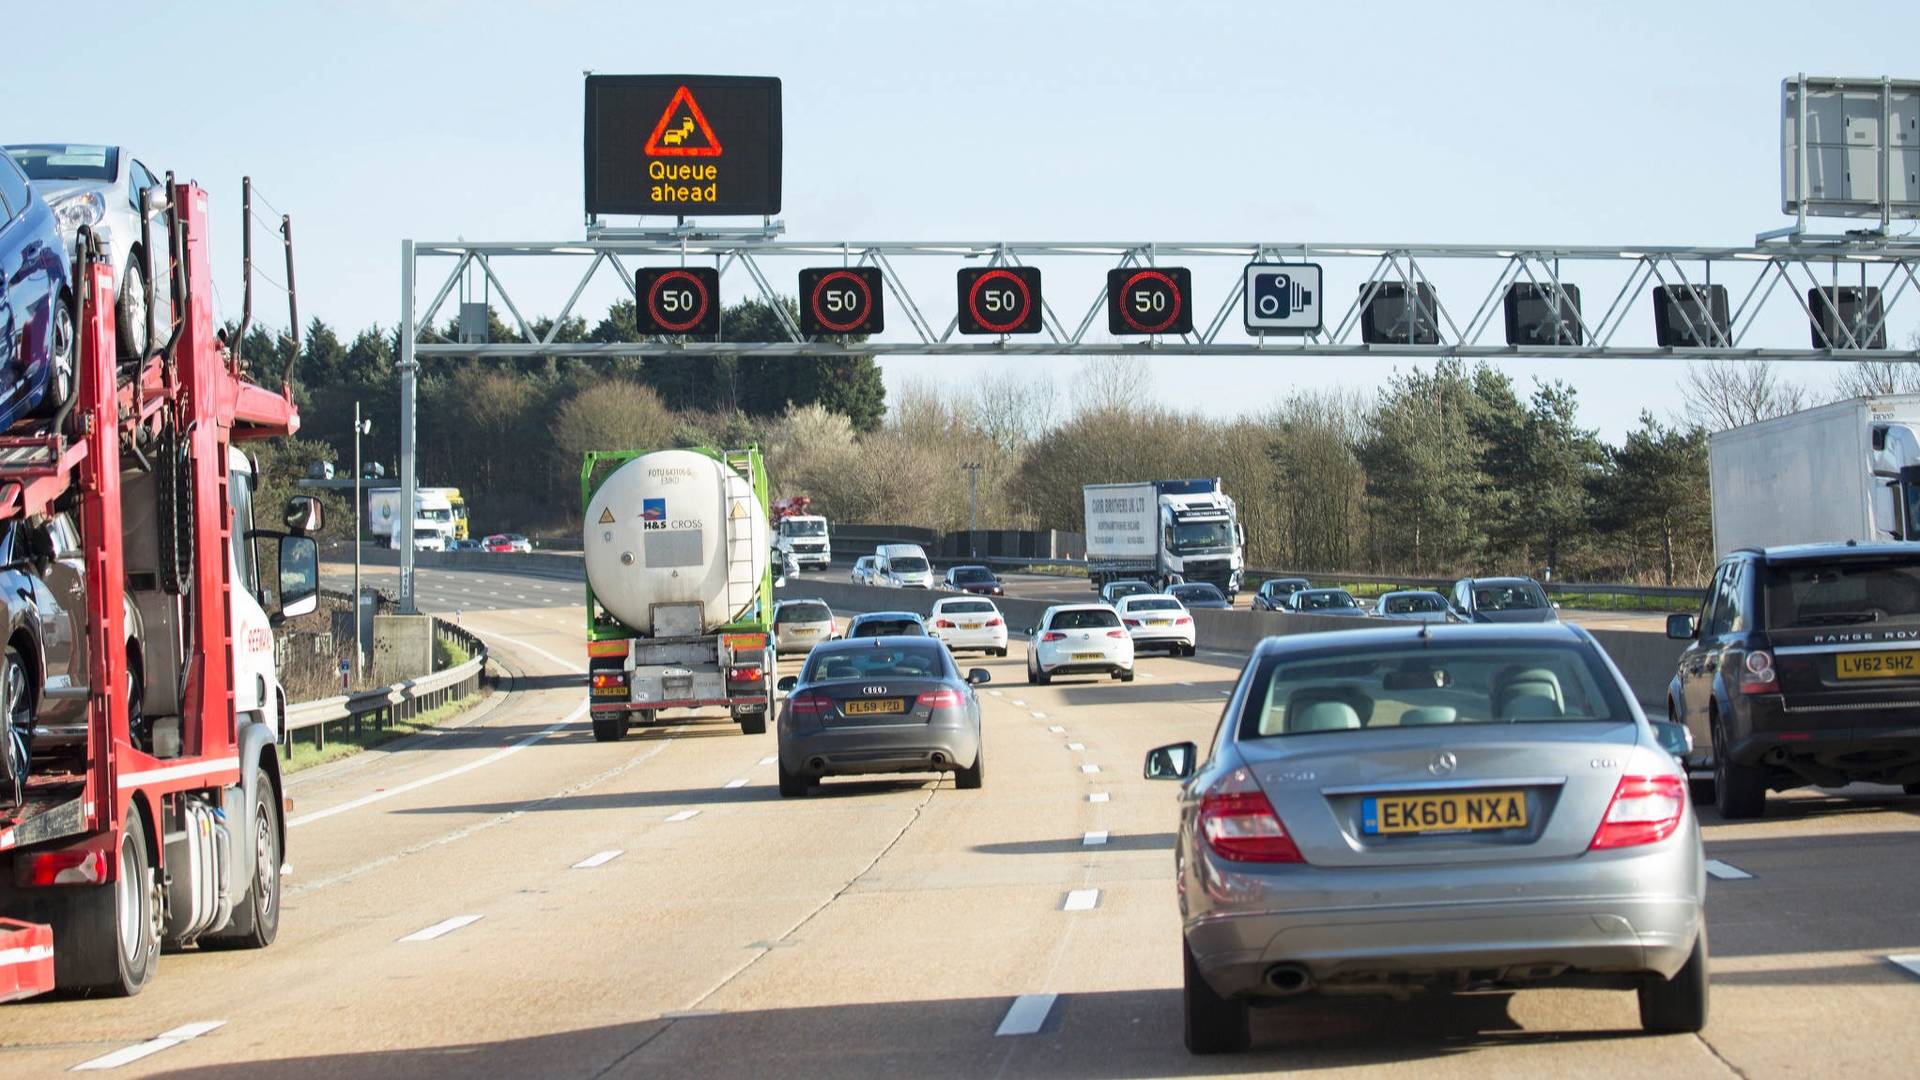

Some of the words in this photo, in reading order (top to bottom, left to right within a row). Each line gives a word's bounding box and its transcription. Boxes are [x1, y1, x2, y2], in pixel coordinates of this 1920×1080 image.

[649, 160, 718, 180] Queue
[651, 182, 717, 202] ahead
[662, 290, 693, 312] 50
[826, 290, 857, 312] 50
[985, 290, 1016, 312] 50
[1134, 290, 1166, 312] 50
[644, 520, 666, 530] H&S
[671, 519, 703, 529] CROSS
[1814, 632, 1873, 642] RANGE
[1843, 657, 1882, 673] LV62
[1383, 800, 1458, 828] EK60
[1467, 797, 1521, 823] NXA
